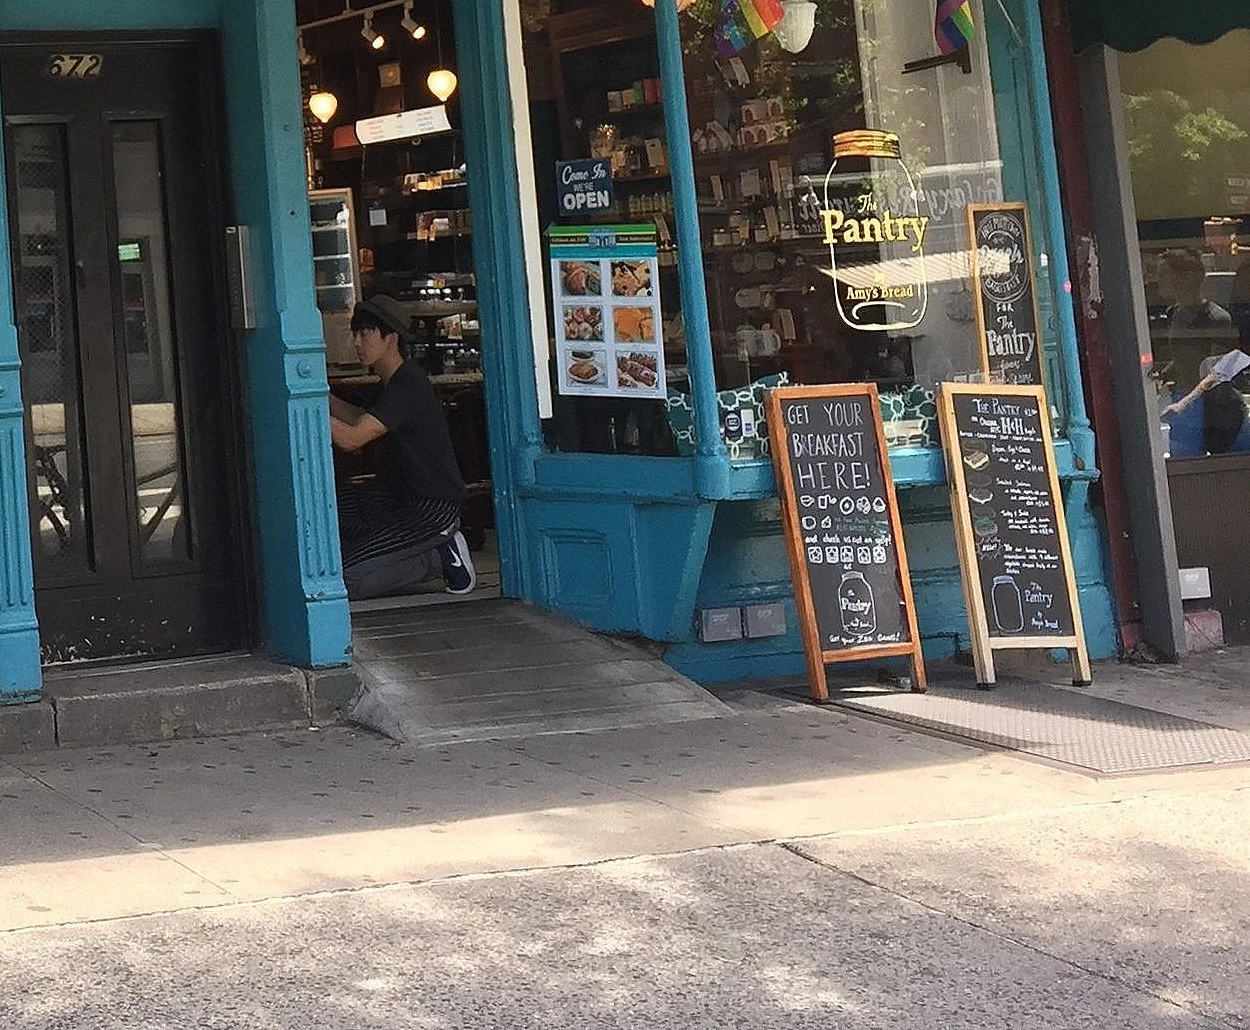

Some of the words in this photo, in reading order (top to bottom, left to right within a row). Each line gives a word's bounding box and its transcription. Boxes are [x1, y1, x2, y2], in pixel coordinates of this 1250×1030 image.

[51, 54, 101, 77] 672
[562, 165, 589, 185] Come
[592, 163, 607, 180] In
[563, 190, 610, 210] OPEN
[857, 192, 878, 214] The
[819, 209, 929, 251] Pantry
[846, 286, 879, 302] Amy's
[880, 284, 914, 299] Bread
[996, 316, 1014, 329] The
[986, 328, 1036, 362] Pantry
[787, 405, 809, 424] GET
[822, 403, 864, 426] YOUR
[792, 432, 864, 458] BREAKFAST
[796, 461, 870, 489] HERE!
[1025, 589, 1053, 608] Pantry
